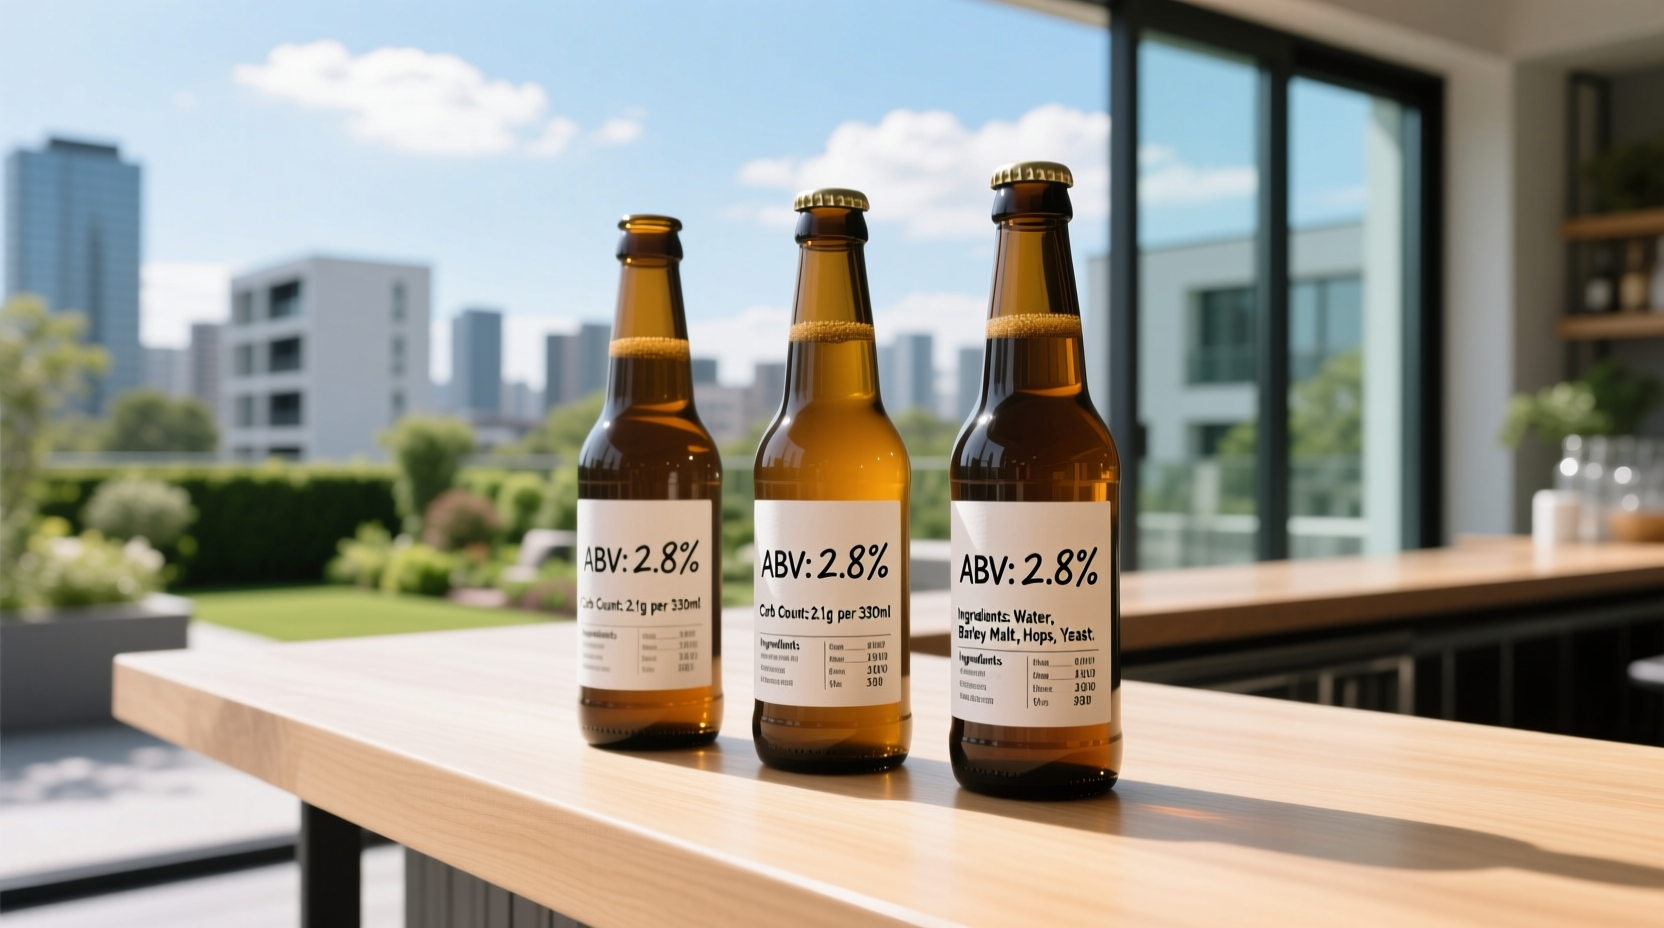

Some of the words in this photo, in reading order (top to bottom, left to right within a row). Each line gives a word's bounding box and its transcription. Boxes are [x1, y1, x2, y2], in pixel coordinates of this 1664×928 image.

[583, 545, 628, 574] ABV:
[633, 539, 699, 576] 2.8%
[761, 549, 812, 579] ABV:
[817, 542, 889, 581] 2.8%
[959, 553, 1015, 586] ABV:
[1021, 546, 1099, 588] 2.8%
[651, 601, 668, 616] per
[811, 605, 833, 624] 2.1g
[837, 609, 857, 624] per
[858, 604, 891, 620] 330ml
[1013, 609, 1055, 626] Water,
[989, 626, 1021, 645] Malt,
[1023, 627, 1057, 646] Hops,
[1060, 627, 1095, 642] Yeast.
